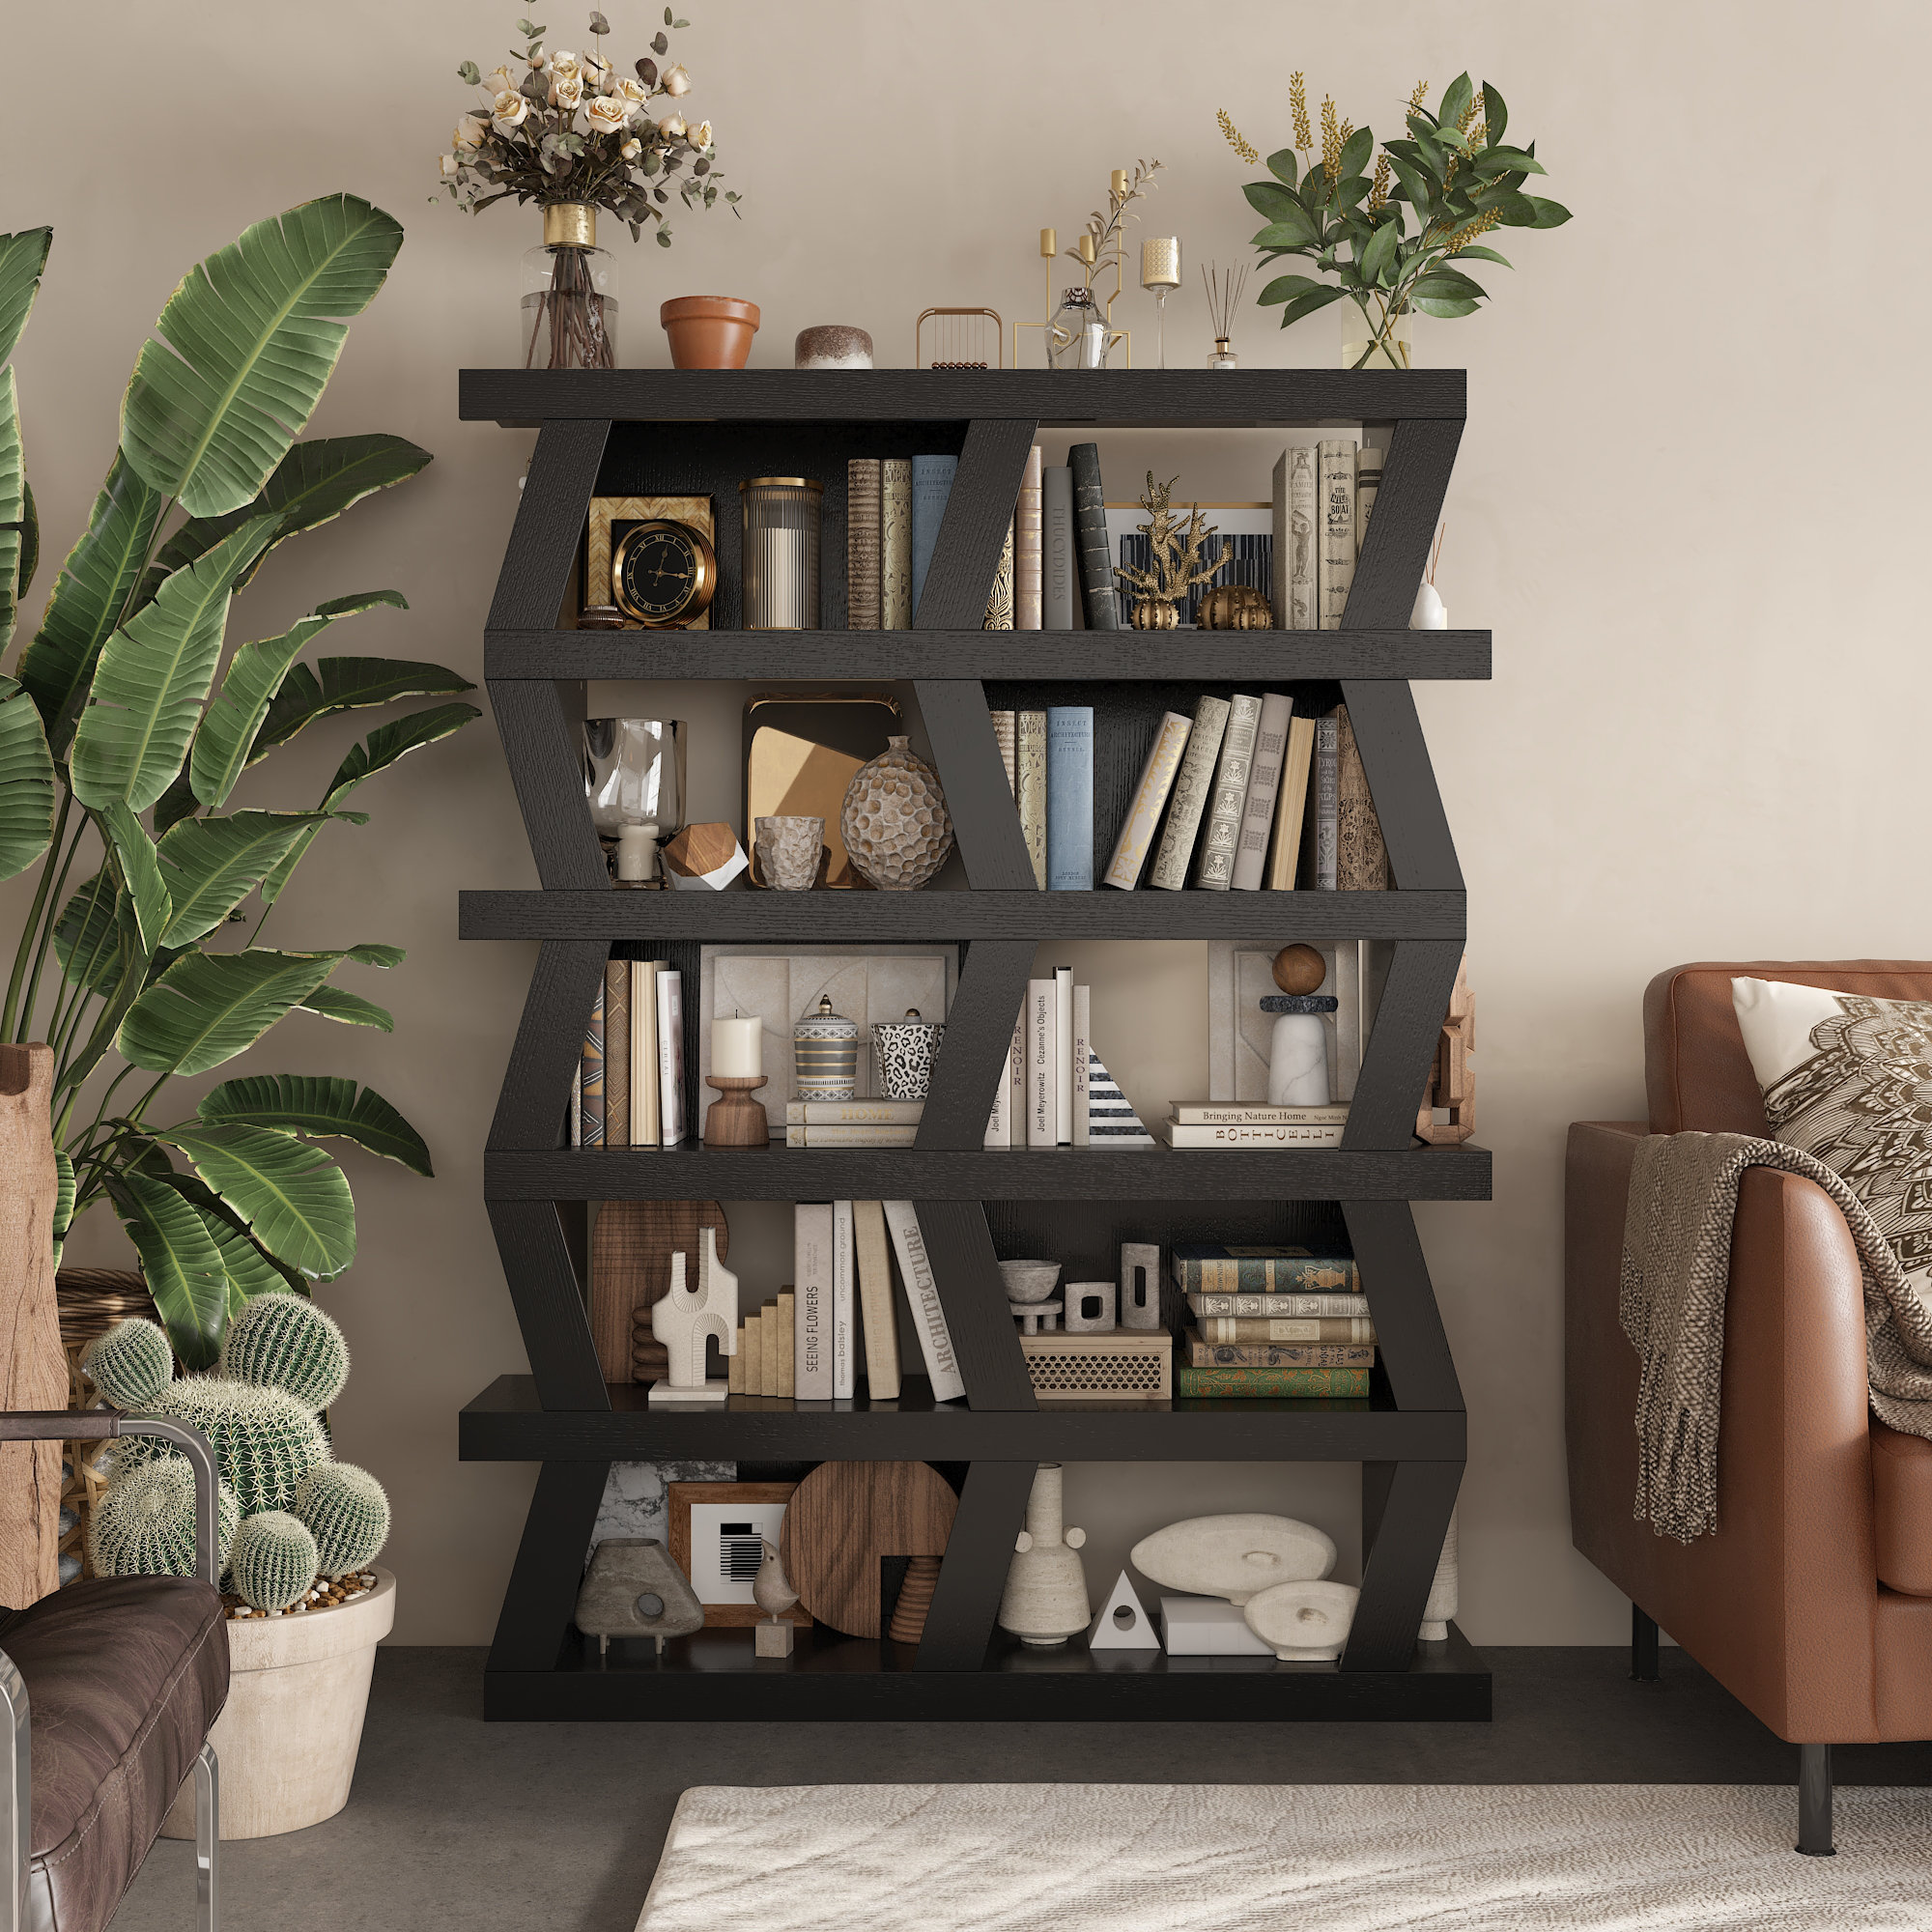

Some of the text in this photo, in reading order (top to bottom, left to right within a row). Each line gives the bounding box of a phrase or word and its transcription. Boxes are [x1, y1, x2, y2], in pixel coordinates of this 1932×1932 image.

[1053, 503, 1065, 600] THUCYDIDES
[1037, 995, 1046, 1024] Objects
[1012, 1026, 1023, 1085] RENOIR
[1037, 1027, 1045, 1065] Cézanne's
[1075, 1038, 1086, 1092] RENOIR
[1037, 1072, 1047, 1114] Meyerowitz
[841, 1108, 895, 1121] HOME
[991, 1116, 1000, 1132] Joel
[1203, 1111, 1242, 1122] Bringing
[1244, 1111, 1277, 1121] Nature
[1279, 1111, 1307, 1121] Home
[1215, 1128, 1334, 1142] BOTTICELLI
[806, 1286, 818, 1333] FLOWERS
[903, 1225, 956, 1374] ARCHITECTURE
[806, 1336, 818, 1373] SEEING
[838, 1321, 847, 1357] balsley
